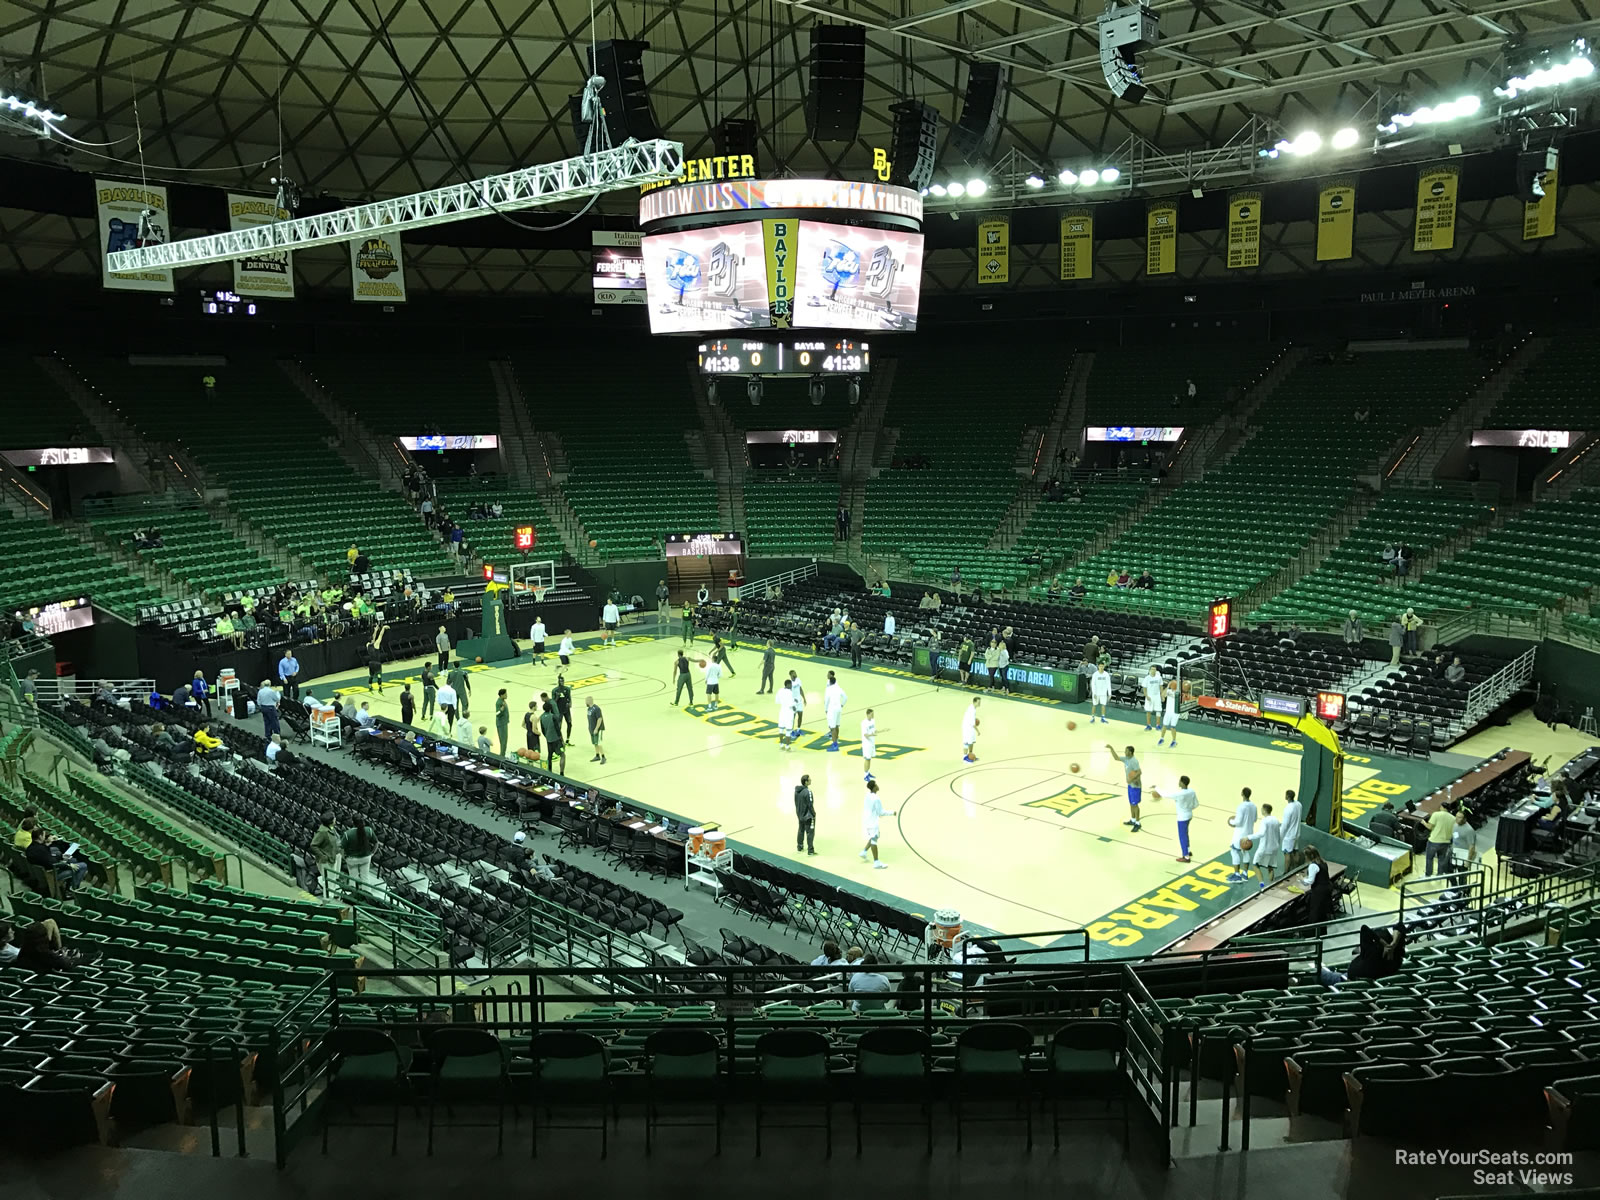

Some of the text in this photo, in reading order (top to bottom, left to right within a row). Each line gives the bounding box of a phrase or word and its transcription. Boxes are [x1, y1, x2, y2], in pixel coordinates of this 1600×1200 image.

[677, 154, 756, 184] CENTER
[873, 147, 891, 181] BU
[98, 187, 166, 211] BAYLOR
[641, 186, 694, 224] FOLLOW
[705, 182, 734, 212] US
[231, 201, 290, 220] BAYLOR
[614, 232, 641, 240] Italian
[246, 261, 282, 271] DENVER
[359, 260, 378, 268] FINAL
[773, 222, 789, 315] BAYLOR
[1361, 292, 1387, 303] PAUL
[1398, 289, 1436, 300] MEYER
[1438, 286, 1477, 298] ARENA
[209, 303, 217, 314] 0
[248, 304, 256, 315] 0
[794, 342, 826, 351] BAYLOR
[705, 356, 740, 372] 41:38
[751, 352, 761, 366] 0
[800, 352, 810, 366] 0
[822, 355, 862, 371] 41:38
[783, 430, 819, 443] #SICEM
[1519, 430, 1569, 448] #SICEM
[40, 448, 88, 465] #SICEM
[519, 534, 531, 546] 30
[1214, 615, 1227, 635] 30
[1007, 668, 1027, 683] EYER
[1027, 671, 1055, 688] ARENA
[1084, 860, 1257, 947] BEARS
